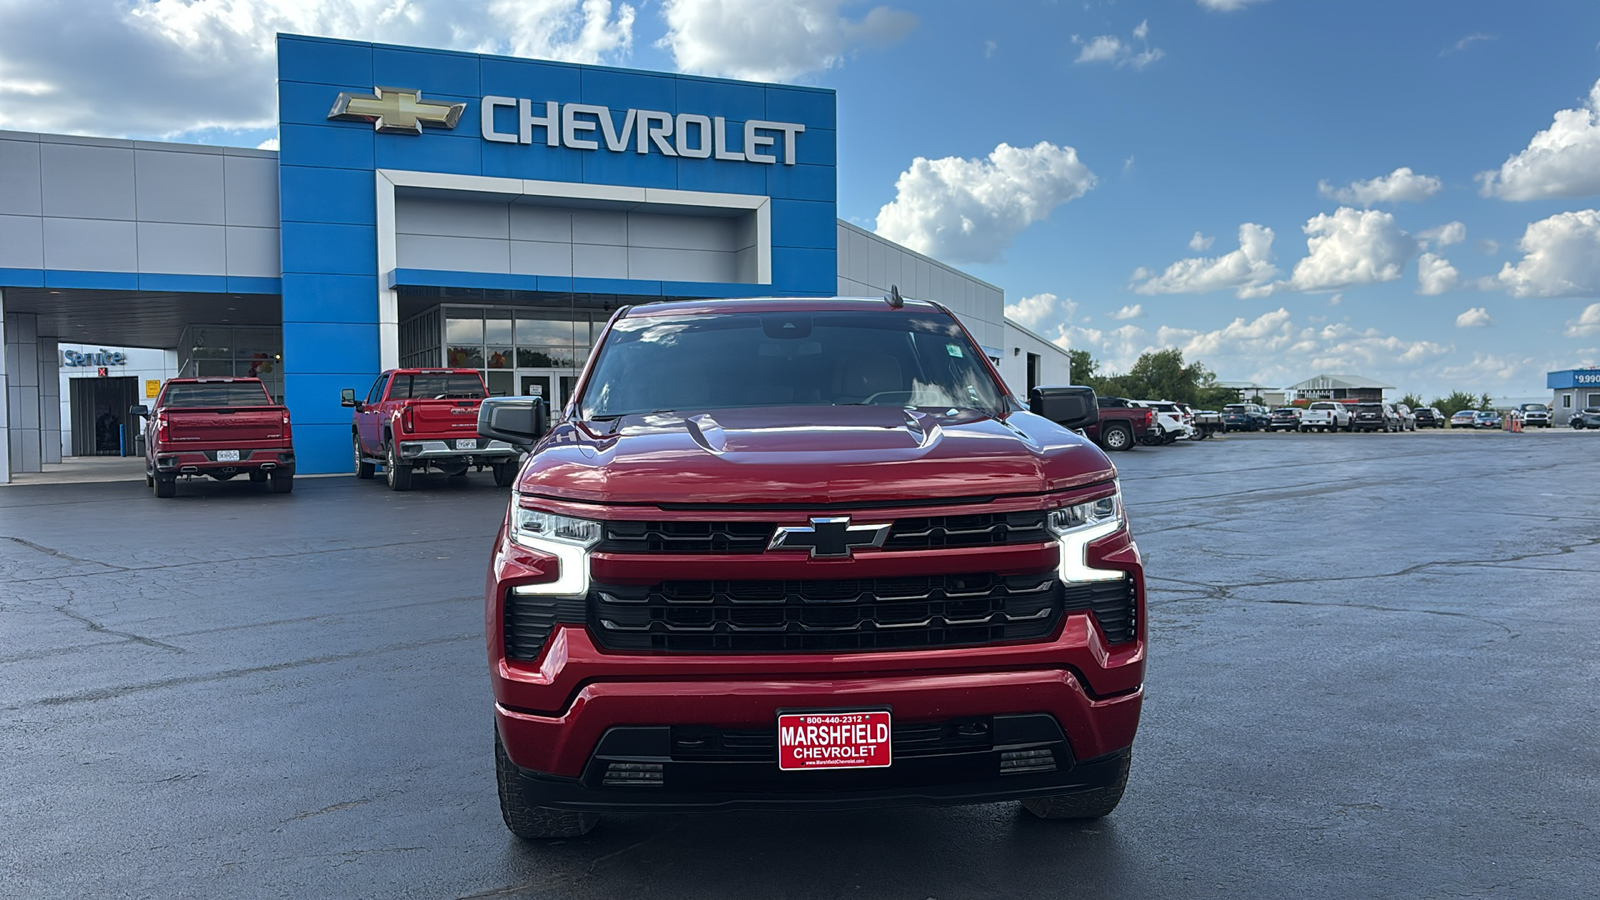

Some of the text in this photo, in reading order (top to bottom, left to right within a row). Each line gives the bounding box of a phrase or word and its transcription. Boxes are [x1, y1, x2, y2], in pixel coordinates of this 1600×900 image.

[481, 95, 805, 165] CHEVROLET
[64, 348, 122, 367] Service
[806, 715, 862, 724] 800-440-2312
[781, 723, 888, 746] MARSHFIELD
[793, 745, 877, 759] CHEVROLET
